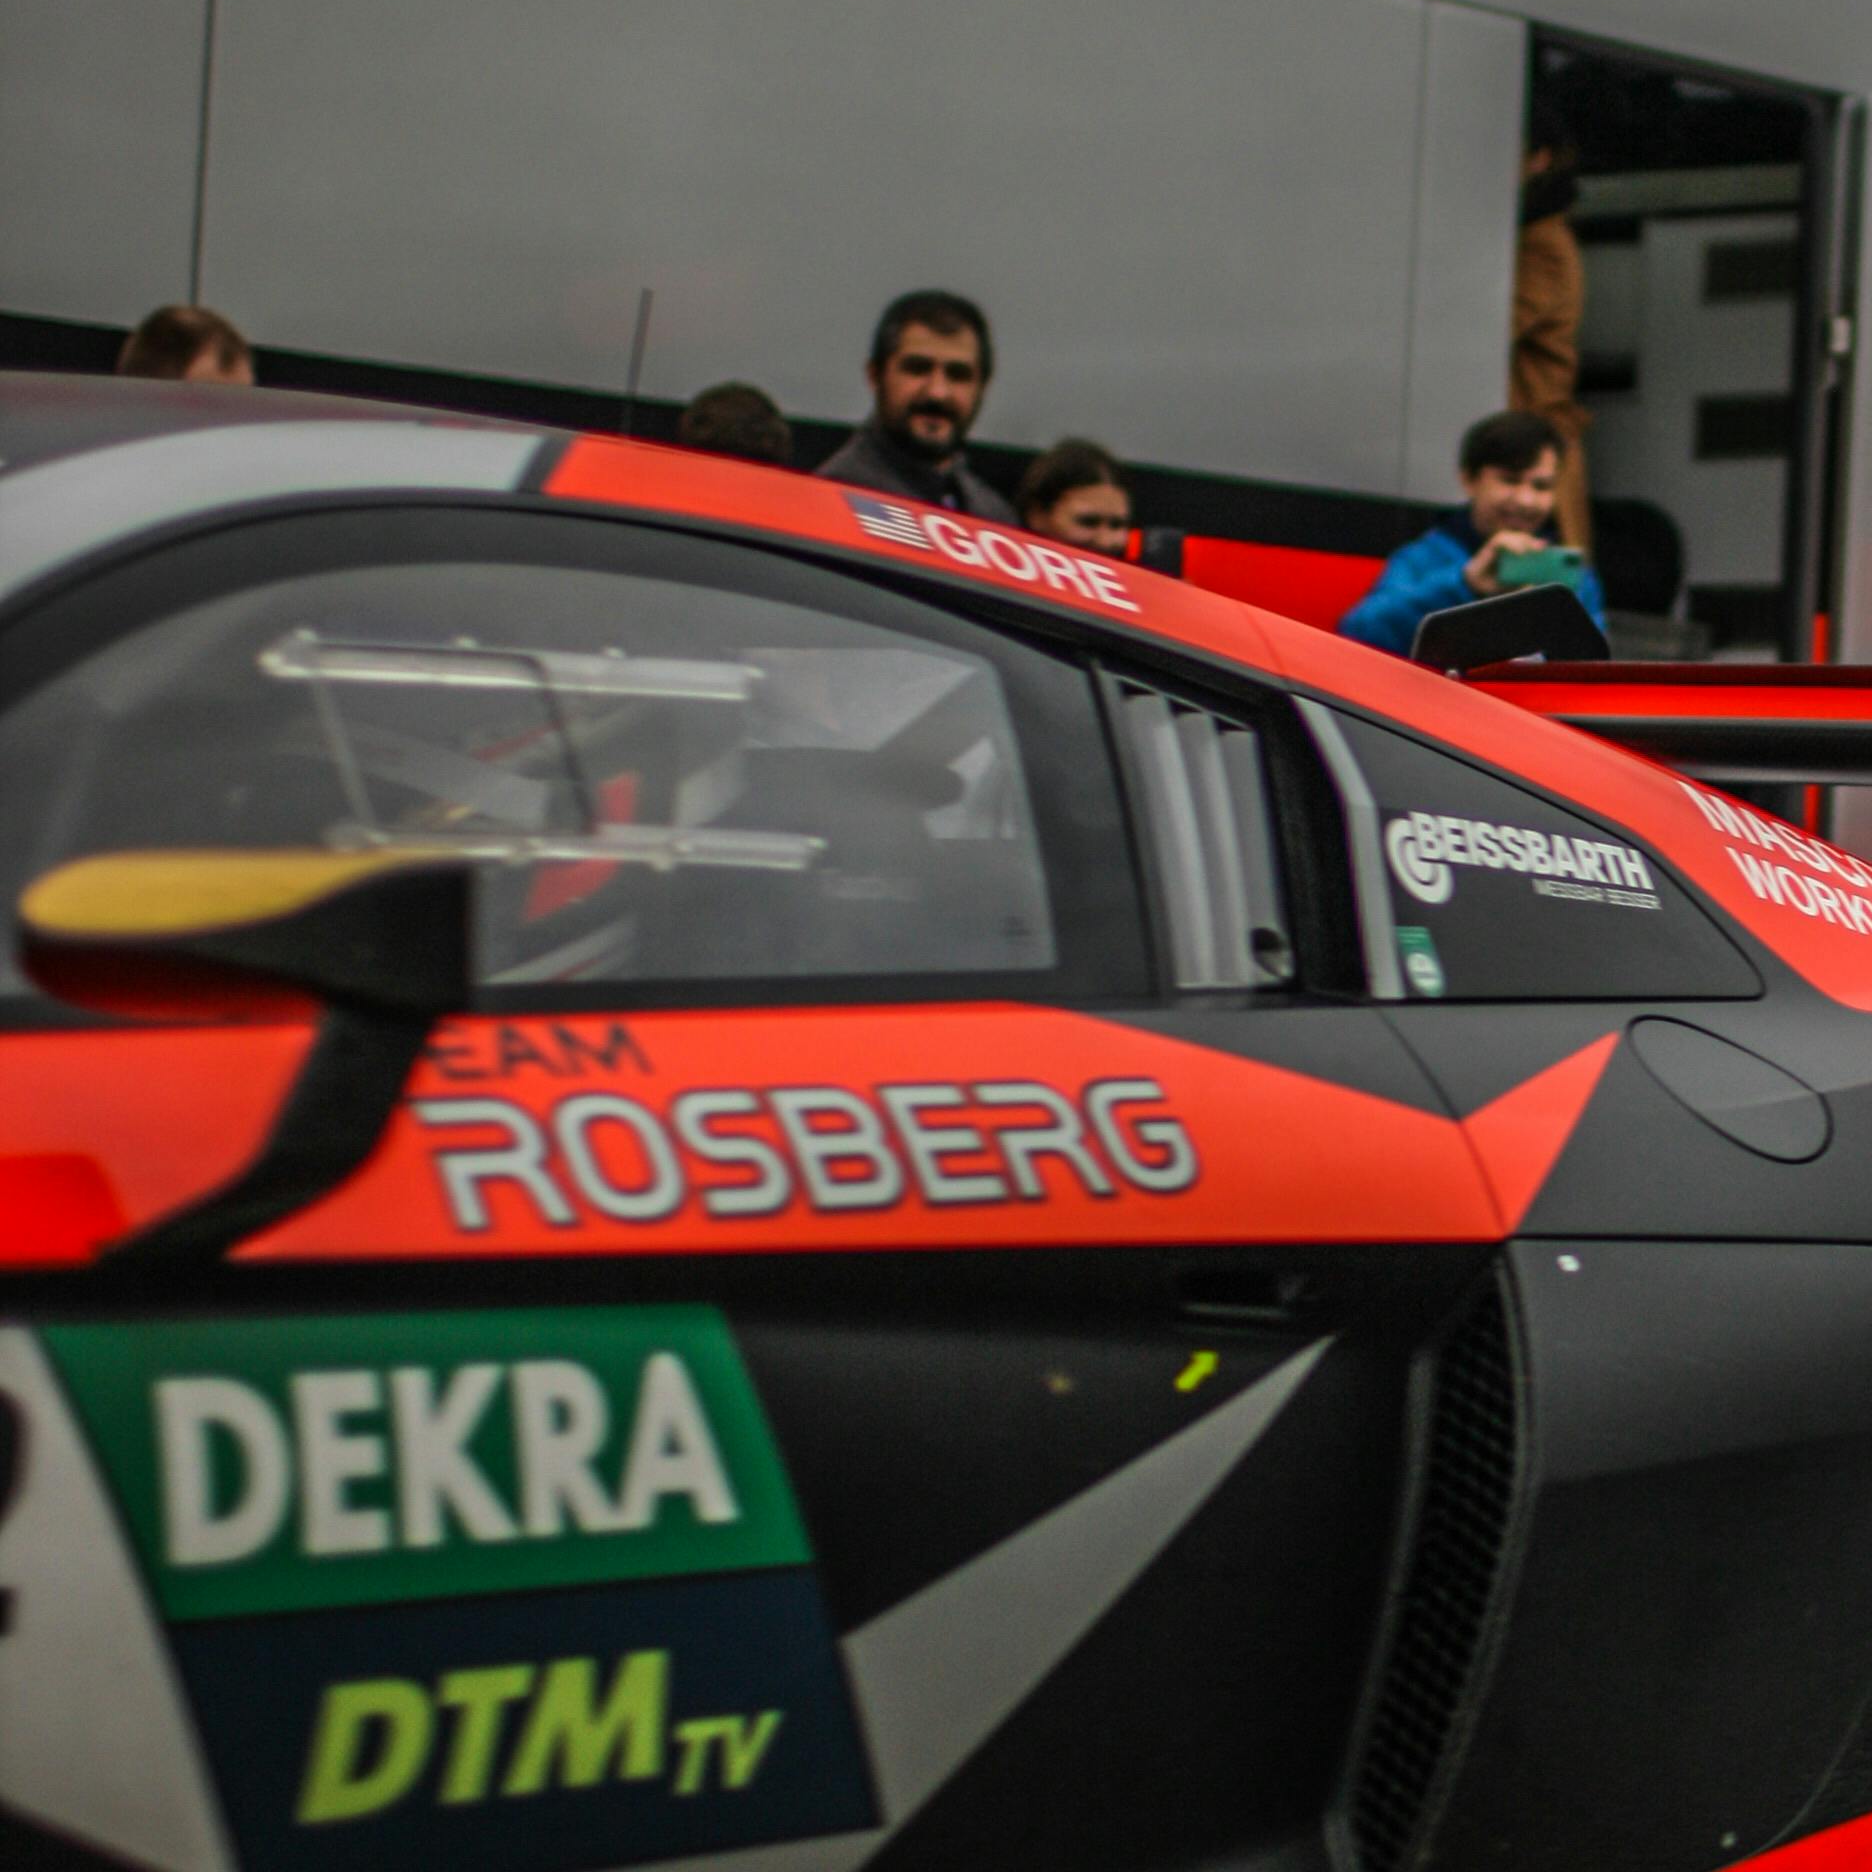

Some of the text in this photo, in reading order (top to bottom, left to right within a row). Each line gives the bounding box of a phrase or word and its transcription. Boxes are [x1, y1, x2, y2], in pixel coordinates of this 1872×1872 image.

[921, 514, 1142, 614] GORE
[1408, 811, 1655, 890] BEISSBARTH
[421, 1018, 656, 1081] EAM
[405, 1076, 1202, 1236] ROSBERG
[152, 1351, 740, 1568] DEKRA
[295, 1648, 784, 1826] DTM TV
